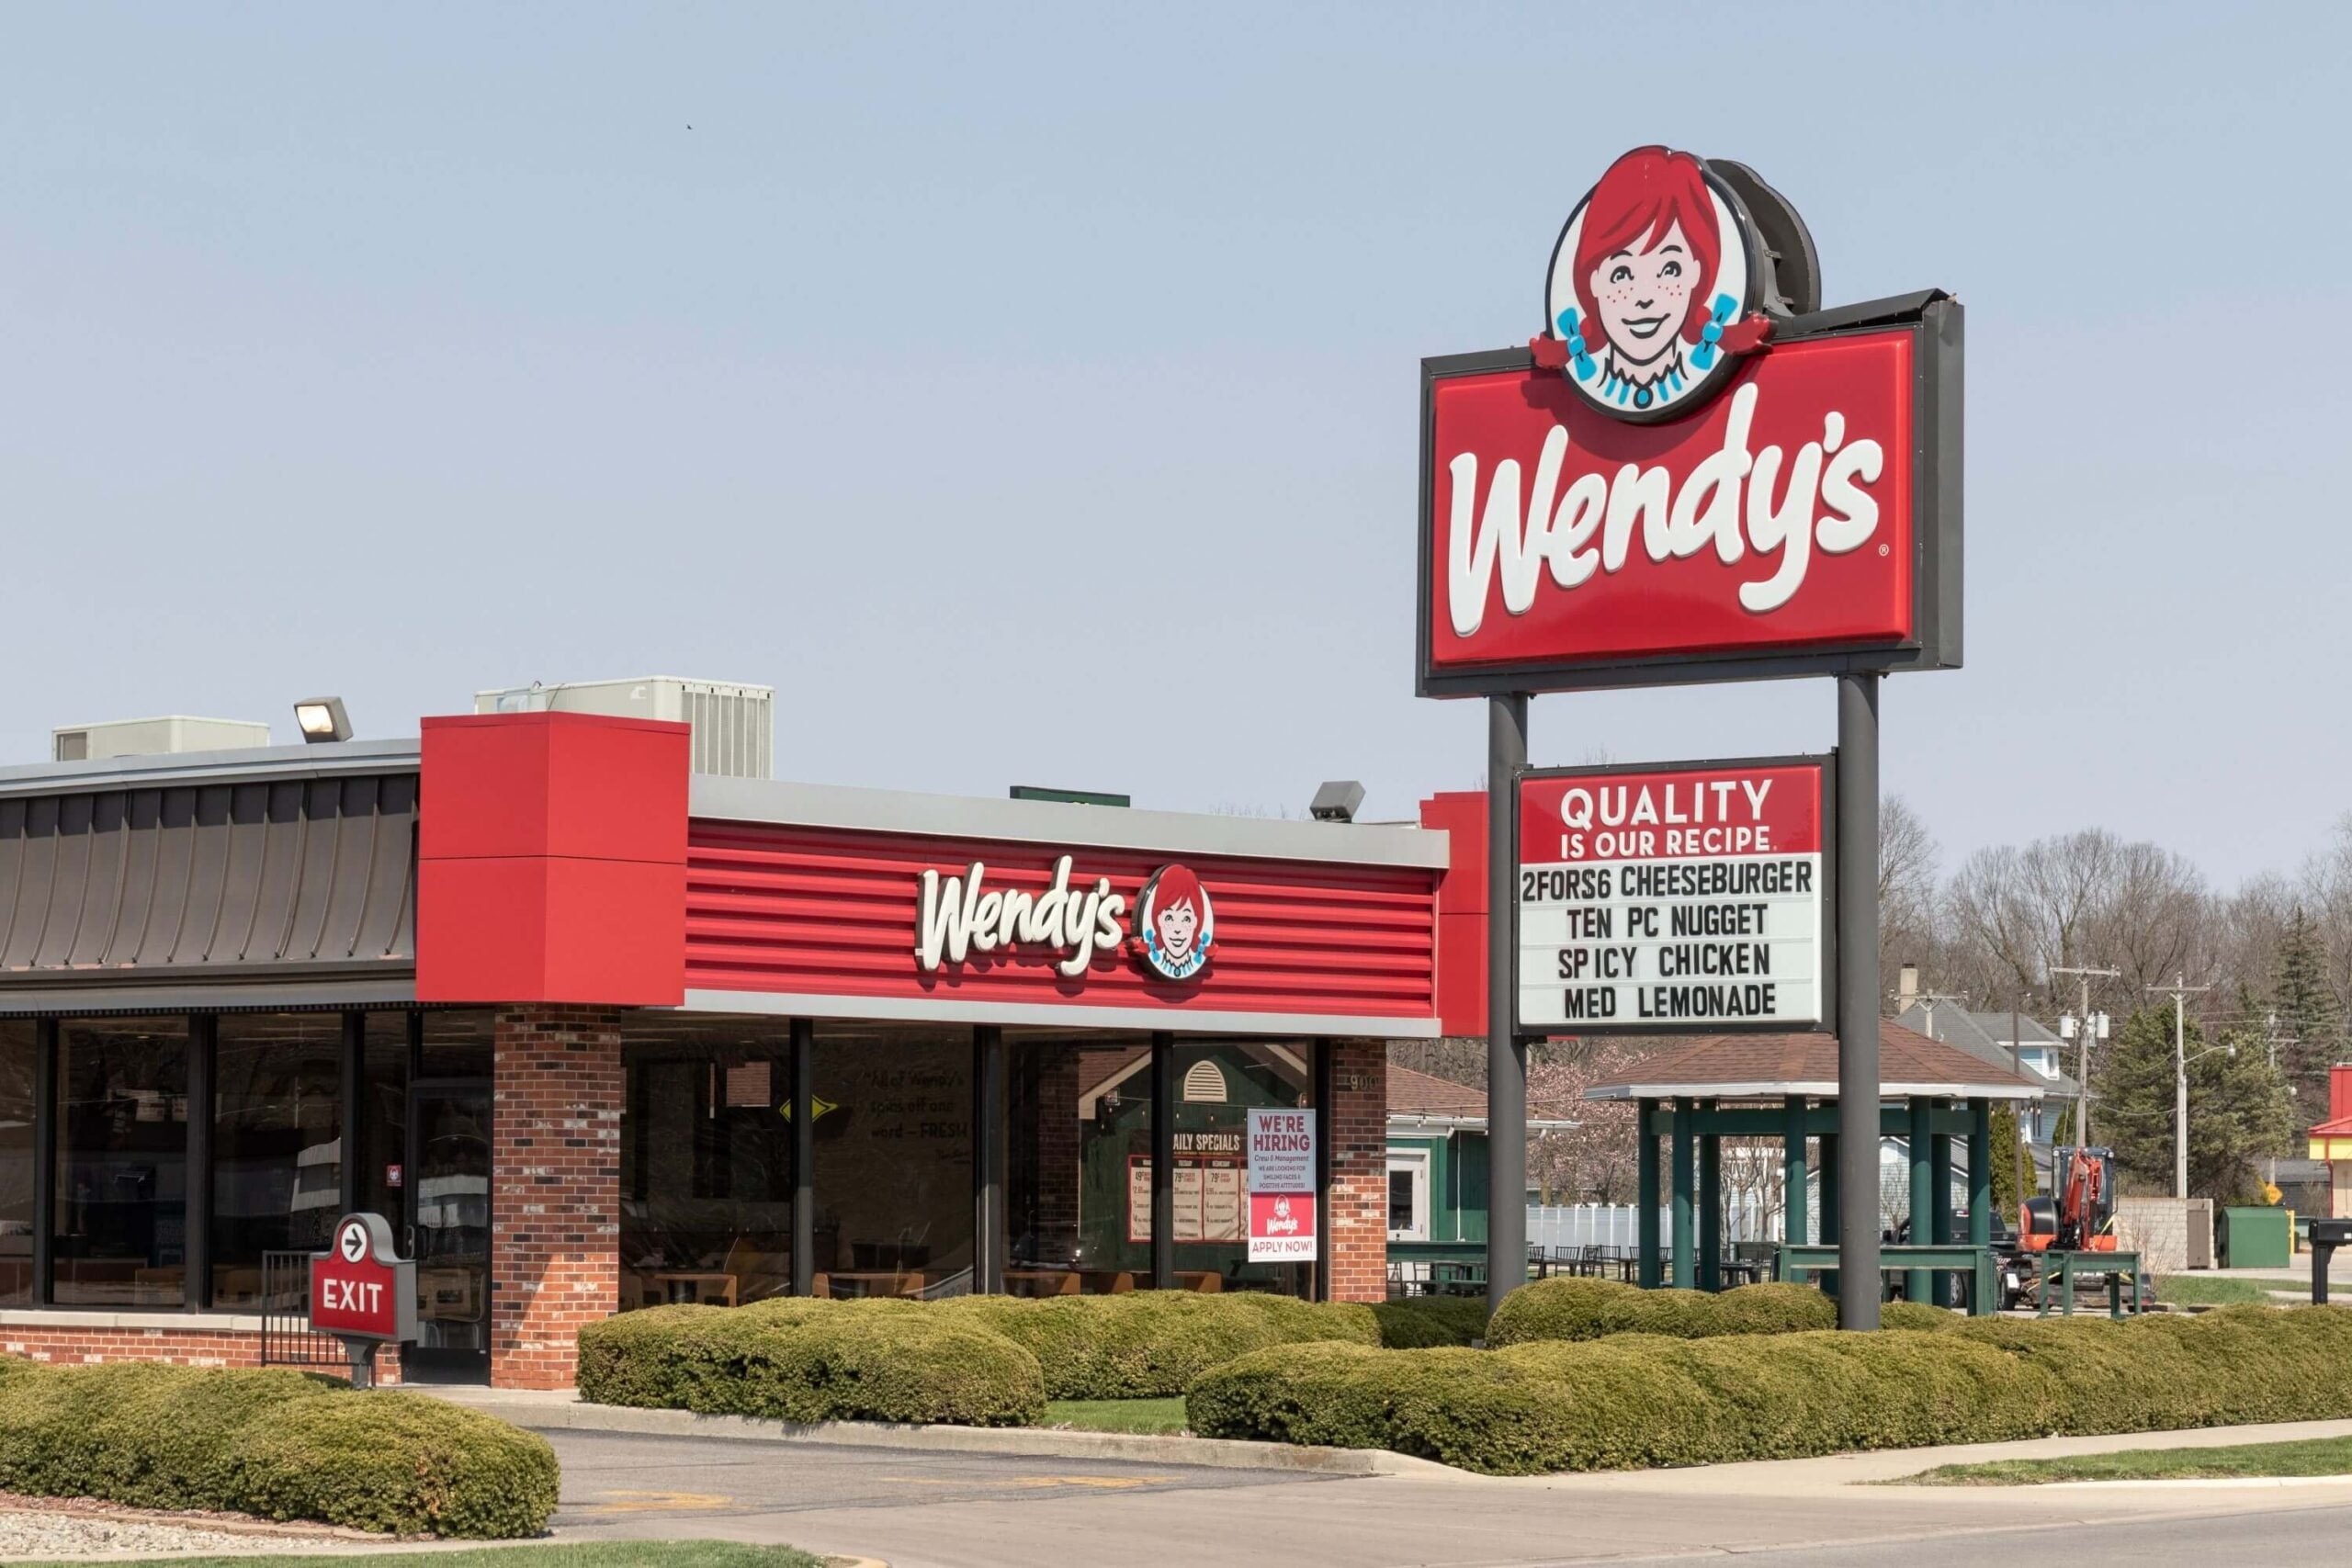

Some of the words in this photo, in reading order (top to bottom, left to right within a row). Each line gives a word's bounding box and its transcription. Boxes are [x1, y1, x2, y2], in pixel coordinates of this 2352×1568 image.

[1449, 382, 1883, 637] Wendy's
[1560, 779, 1773, 831] QUALITY
[1561, 833, 1585, 860] IS
[1595, 830, 1655, 857] OUR
[1621, 861, 1813, 897] CHEESEBURGER
[920, 854, 1126, 977] Wendy's
[1566, 908, 1612, 940] TEN
[1627, 907, 1659, 938] PC
[1671, 904, 1769, 937] NUGGET
[1558, 946, 1638, 979] SPICY
[1658, 943, 1770, 977] CHICKEN
[1564, 987, 1616, 1019] MED
[1638, 983, 1776, 1018] LEMONADE
[1259, 1115, 1305, 1133] WE'RE
[1172, 1134, 1193, 1151] AILY
[1196, 1134, 1240, 1151] SPECIALS
[1253, 1134, 1310, 1151] HIRING
[1275, 1155, 1309, 1164] Management
[1266, 1214, 1298, 1235] Wendy's
[1252, 1241, 1283, 1253] APPLY
[1285, 1240, 1313, 1253] NOW!
[323, 1278, 383, 1314] EXIT
